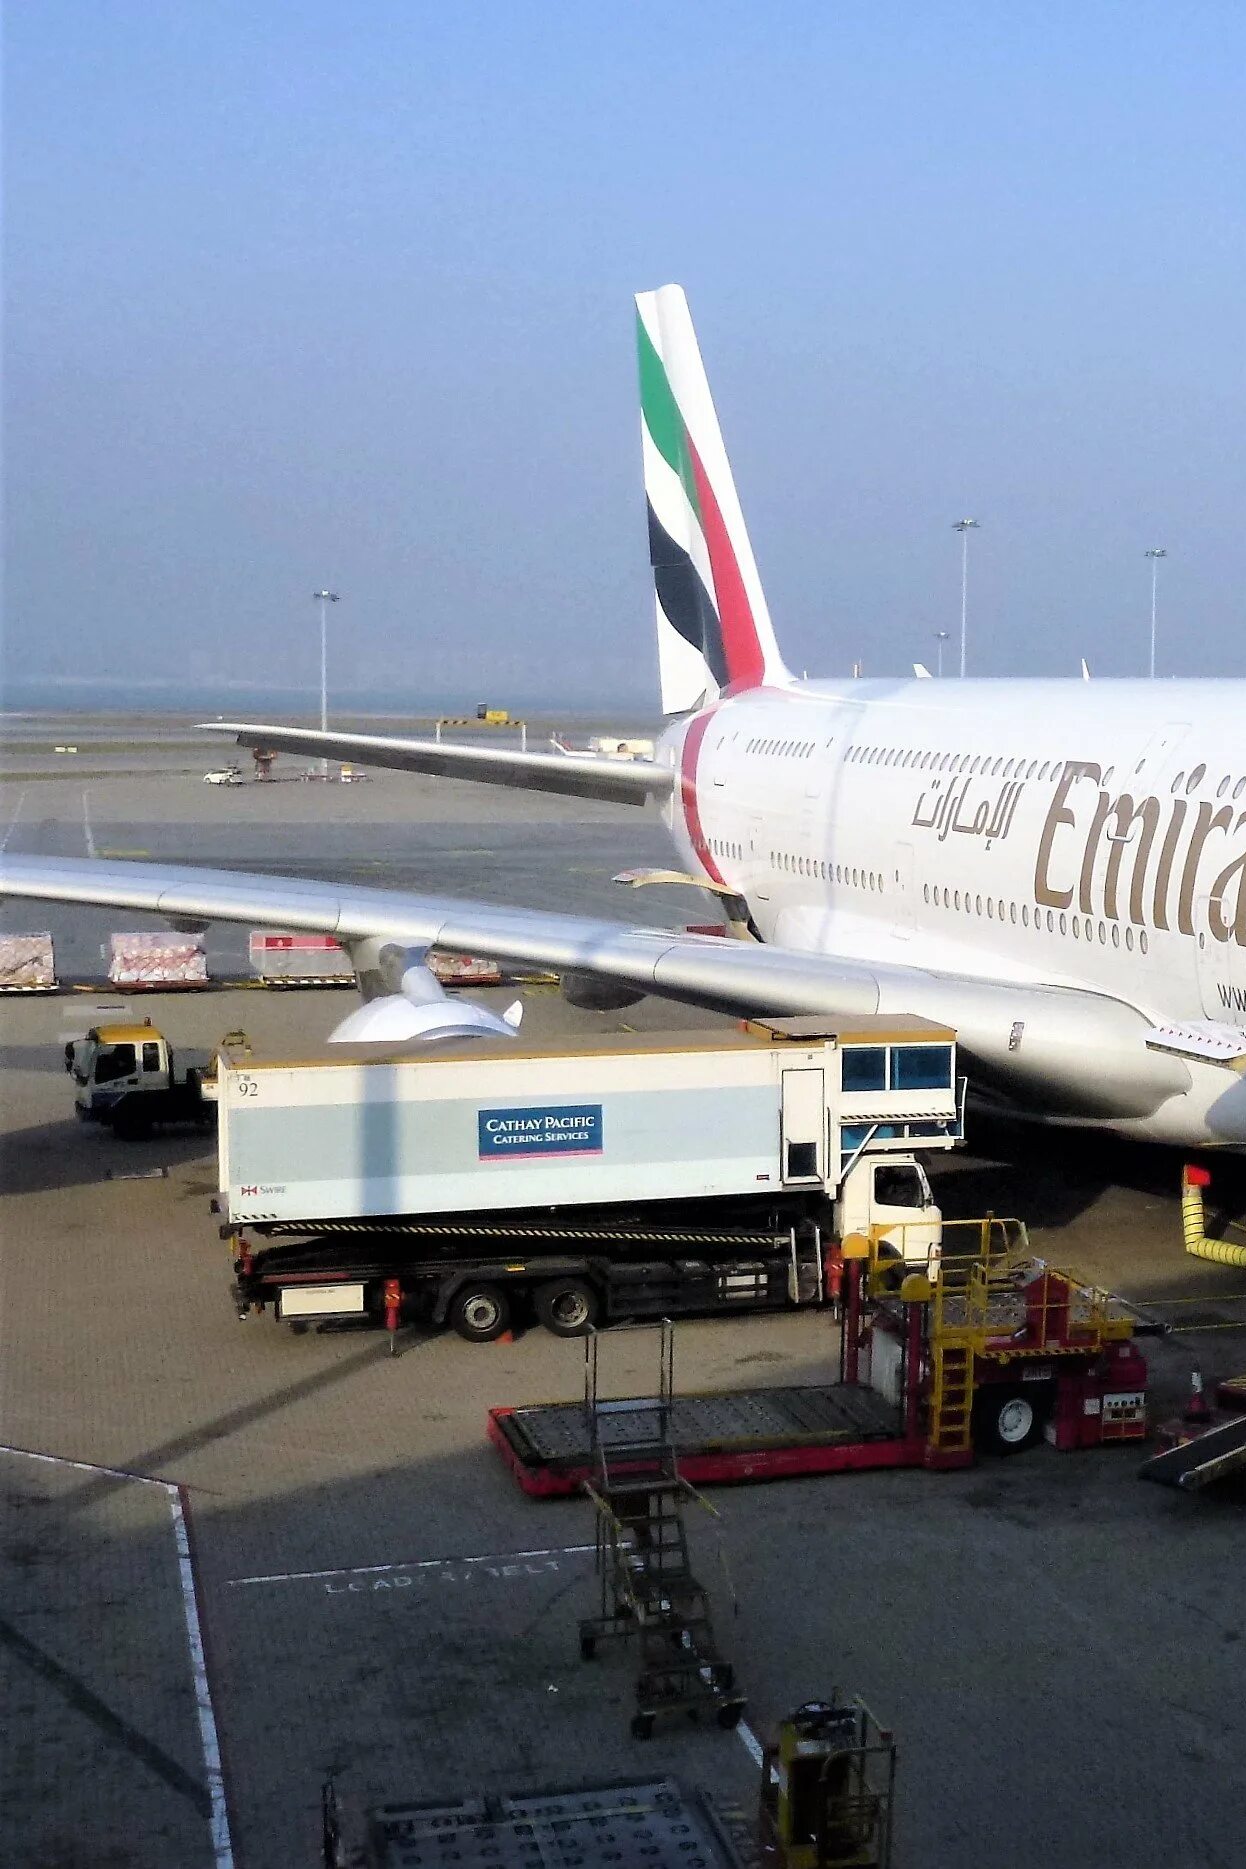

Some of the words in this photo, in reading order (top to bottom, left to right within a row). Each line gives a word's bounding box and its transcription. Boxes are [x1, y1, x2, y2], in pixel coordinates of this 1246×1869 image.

[911, 776, 1025, 851] الإمارات
[239, 1082, 259, 1098] 92
[486, 1118, 543, 1132] CATHAY
[545, 1116, 595, 1129] PACIFIC
[493, 1134, 543, 1144] CATERING
[545, 1131, 589, 1142] SERVICES
